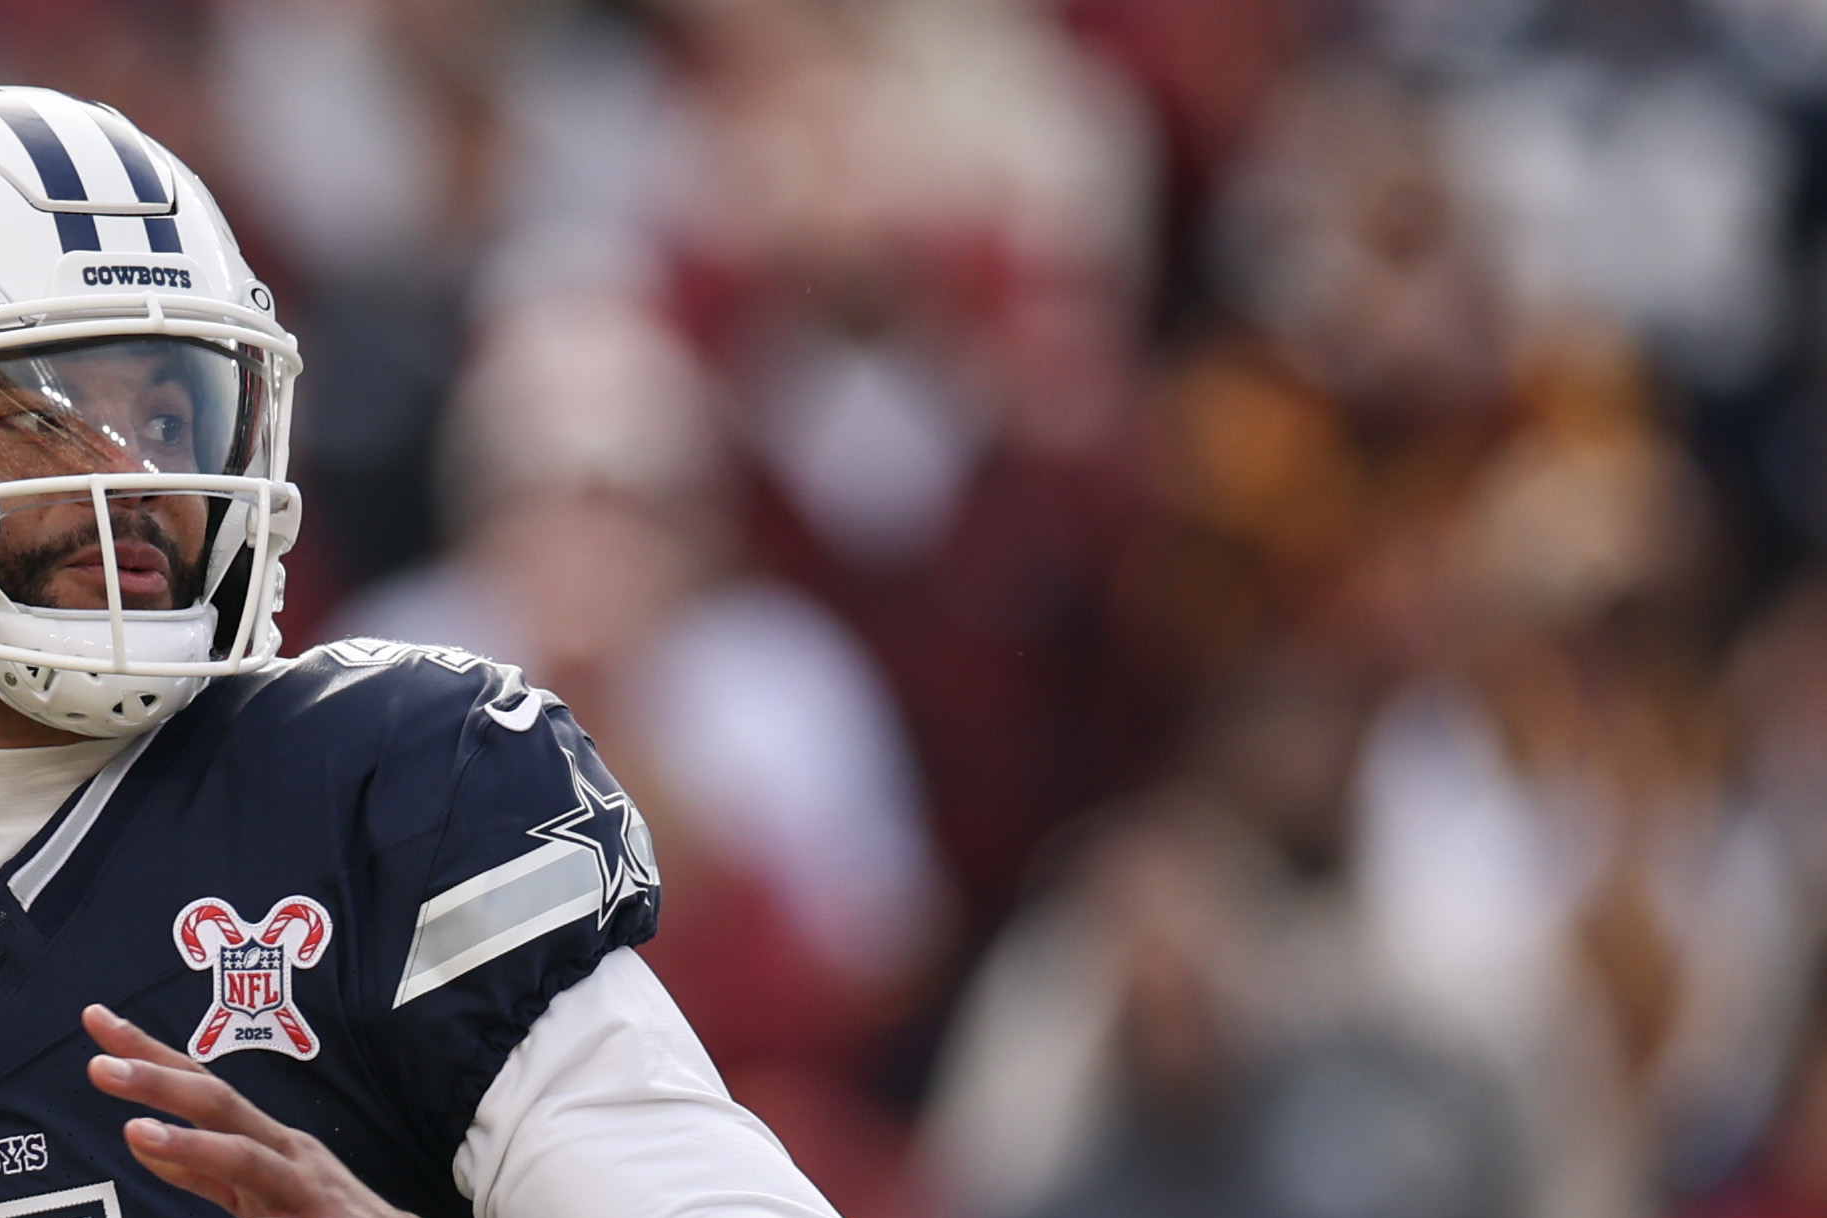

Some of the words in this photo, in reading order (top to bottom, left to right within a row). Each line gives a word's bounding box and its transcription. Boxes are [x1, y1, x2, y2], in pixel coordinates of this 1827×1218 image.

[82, 265, 192, 289] COWBOYS
[226, 972, 279, 1010] NFL
[234, 1027, 274, 1041] 2025
